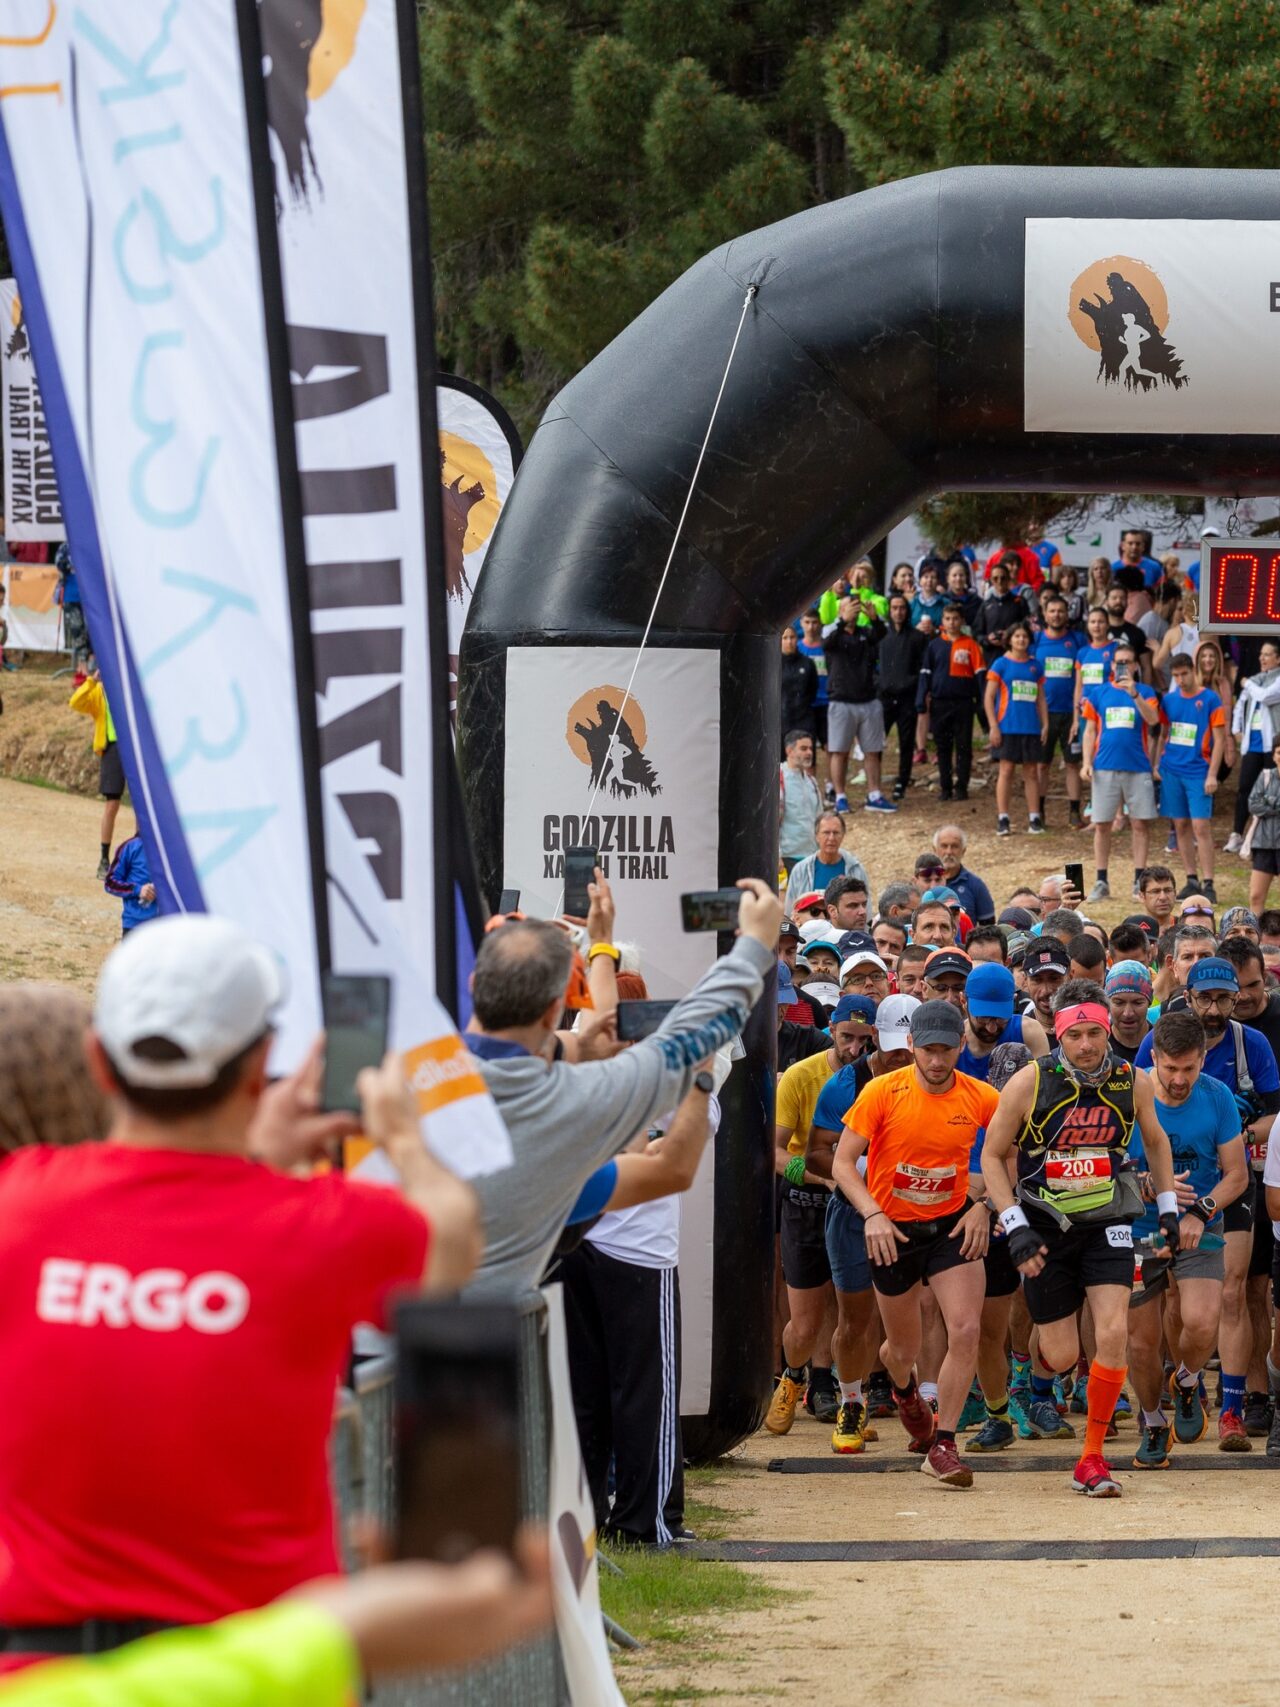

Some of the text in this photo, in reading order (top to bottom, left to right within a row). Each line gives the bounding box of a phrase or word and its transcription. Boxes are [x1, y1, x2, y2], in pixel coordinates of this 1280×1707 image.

[543, 814, 676, 854] GODZILLA
[617, 855, 669, 880] TRAIL
[1198, 968, 1232, 981] UTMB
[1062, 1159, 1095, 1177] 200
[908, 1177, 943, 1191] 227
[36, 1257, 250, 1335] ERGO
